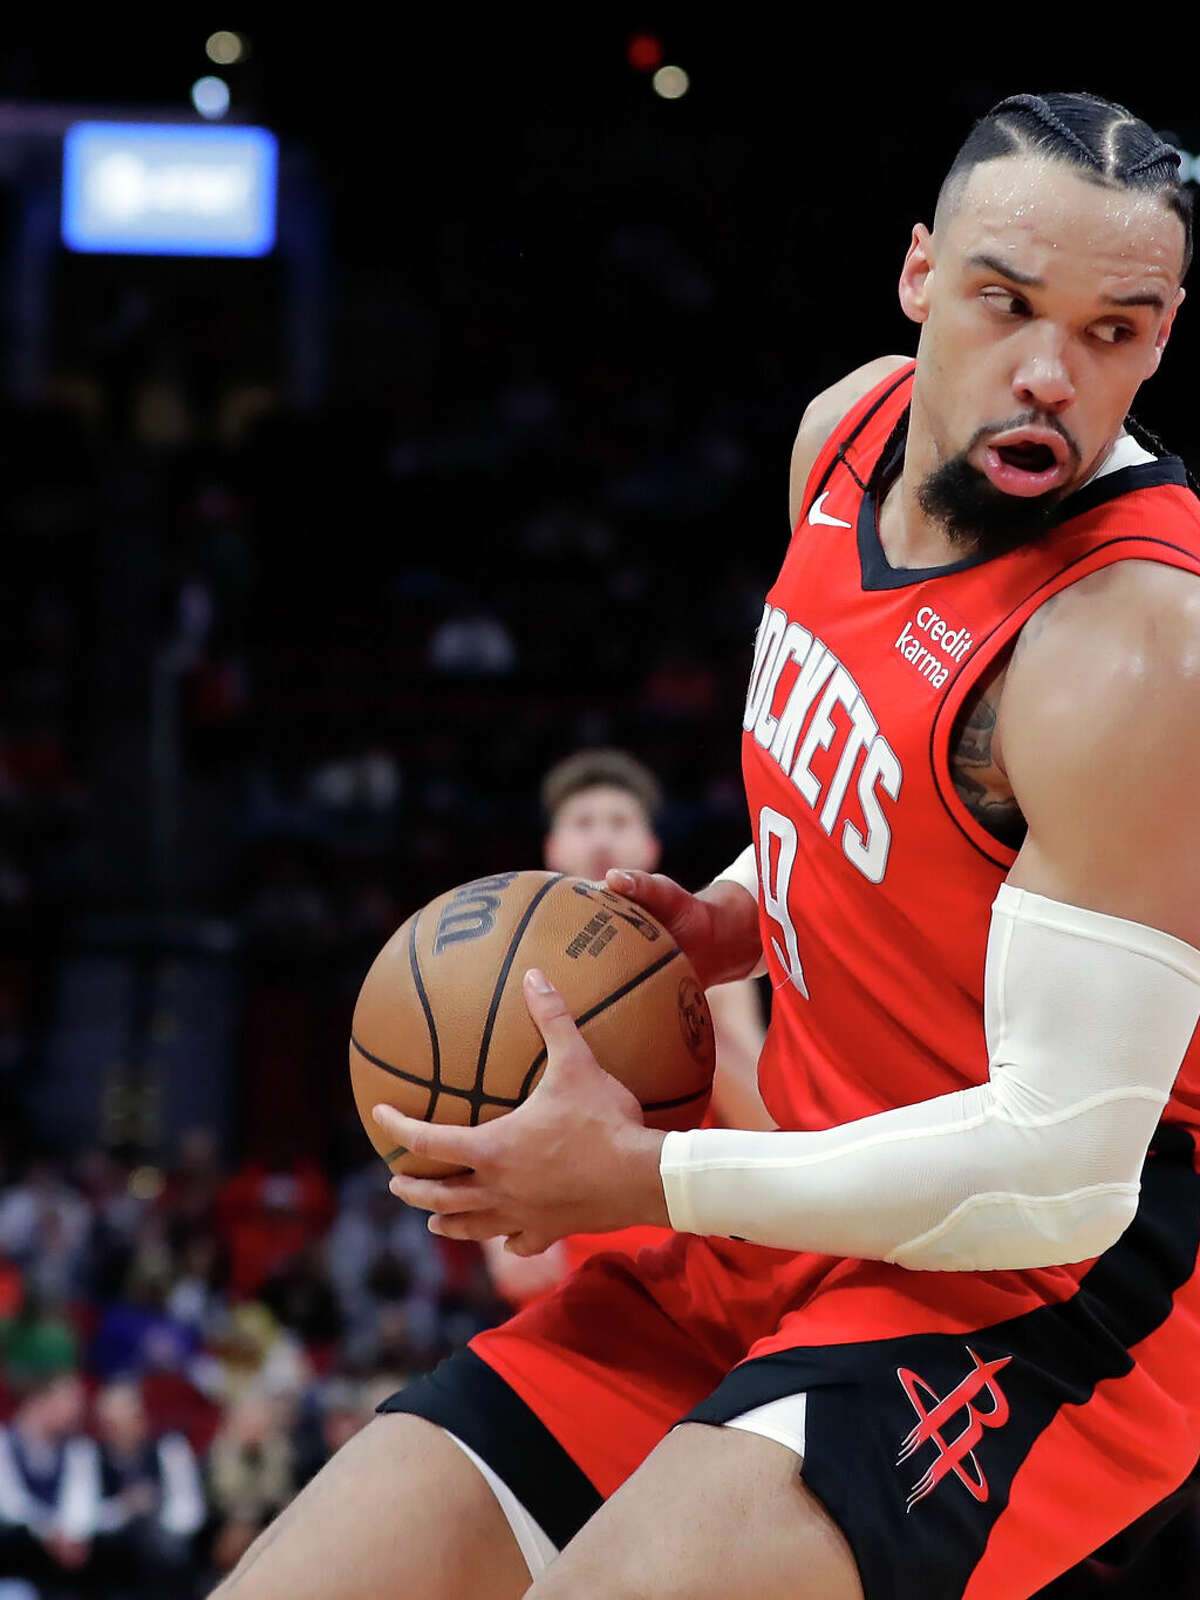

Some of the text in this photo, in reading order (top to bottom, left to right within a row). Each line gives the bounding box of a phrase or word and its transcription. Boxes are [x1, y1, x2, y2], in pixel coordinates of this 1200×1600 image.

[895, 621, 949, 689] karma
[916, 606, 973, 663] credit
[742, 603, 903, 885] OCKETS
[759, 806, 810, 1001] 9
